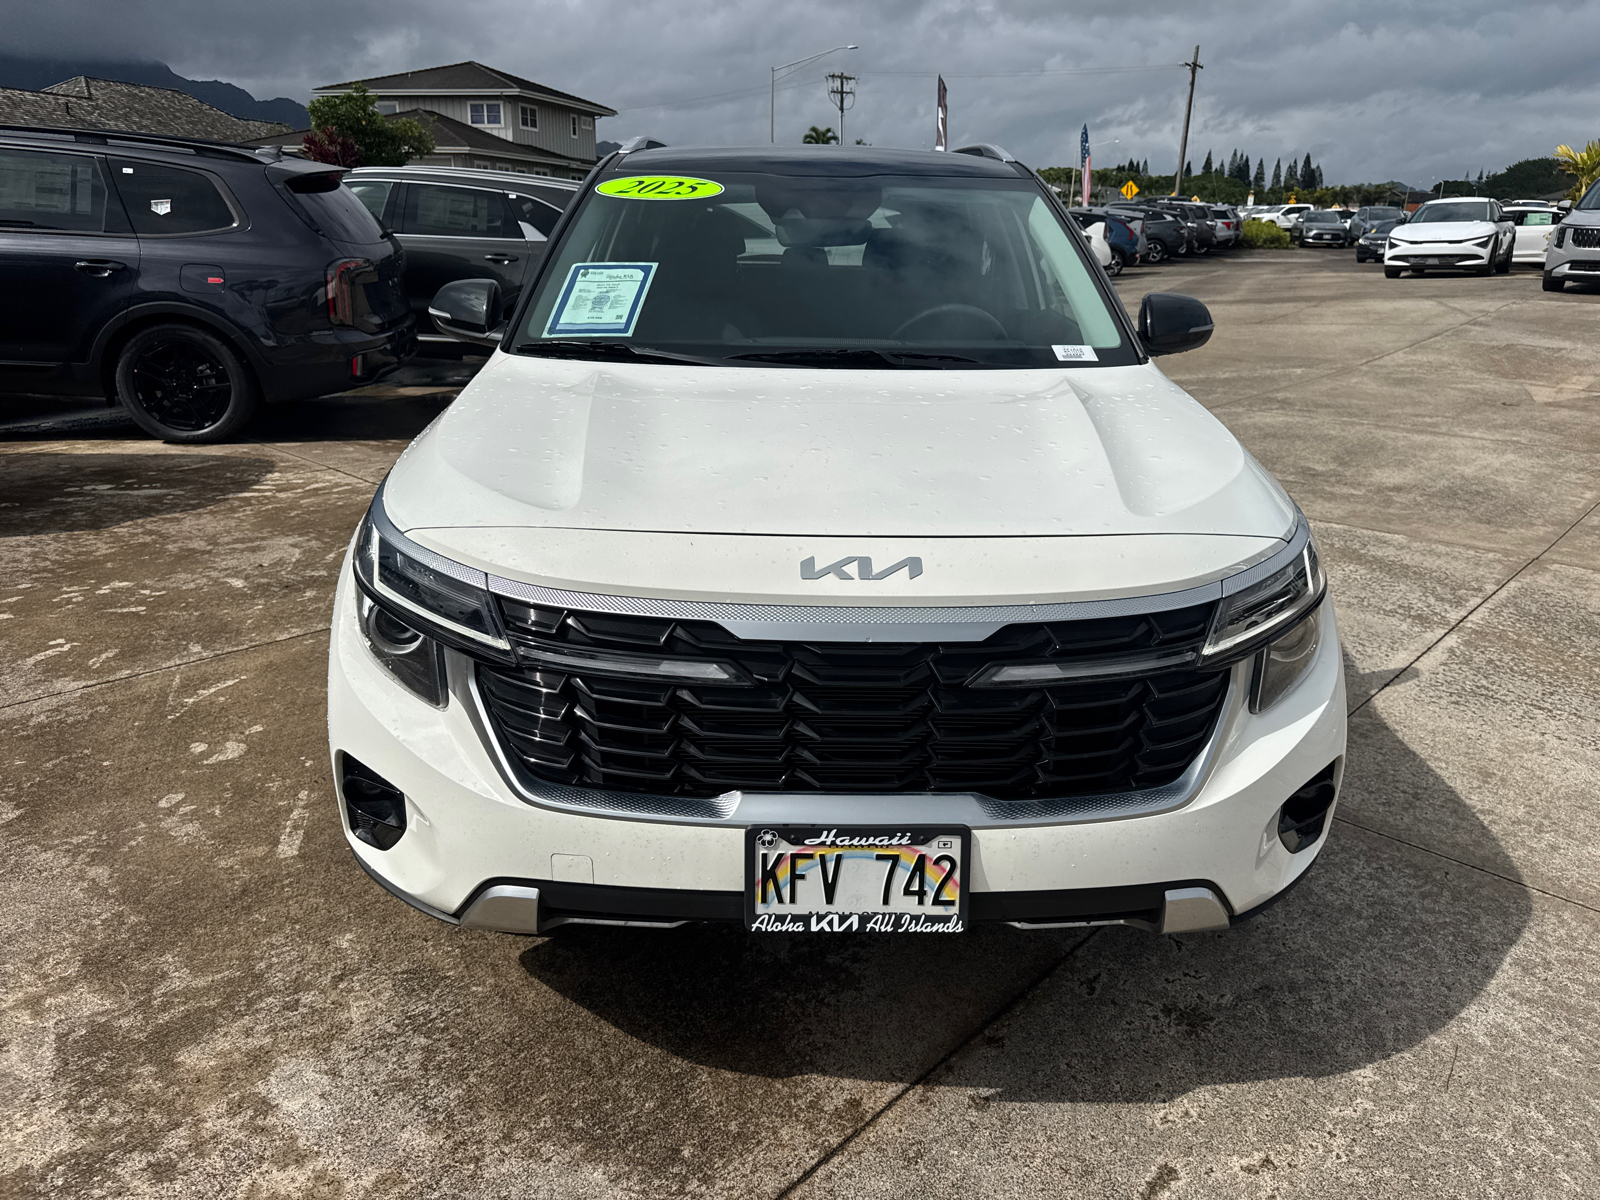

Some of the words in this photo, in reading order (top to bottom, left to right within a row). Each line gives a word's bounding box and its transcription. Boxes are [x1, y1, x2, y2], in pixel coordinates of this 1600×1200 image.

[613, 180, 709, 196] 2025
[800, 555, 923, 581] KIA
[804, 828, 912, 846] Hawaii
[760, 852, 842, 905] KFV
[875, 853, 957, 906] 742
[751, 914, 805, 933] Aloha
[810, 914, 860, 932] KIA
[865, 914, 894, 933] All
[897, 914, 964, 933] Islands
